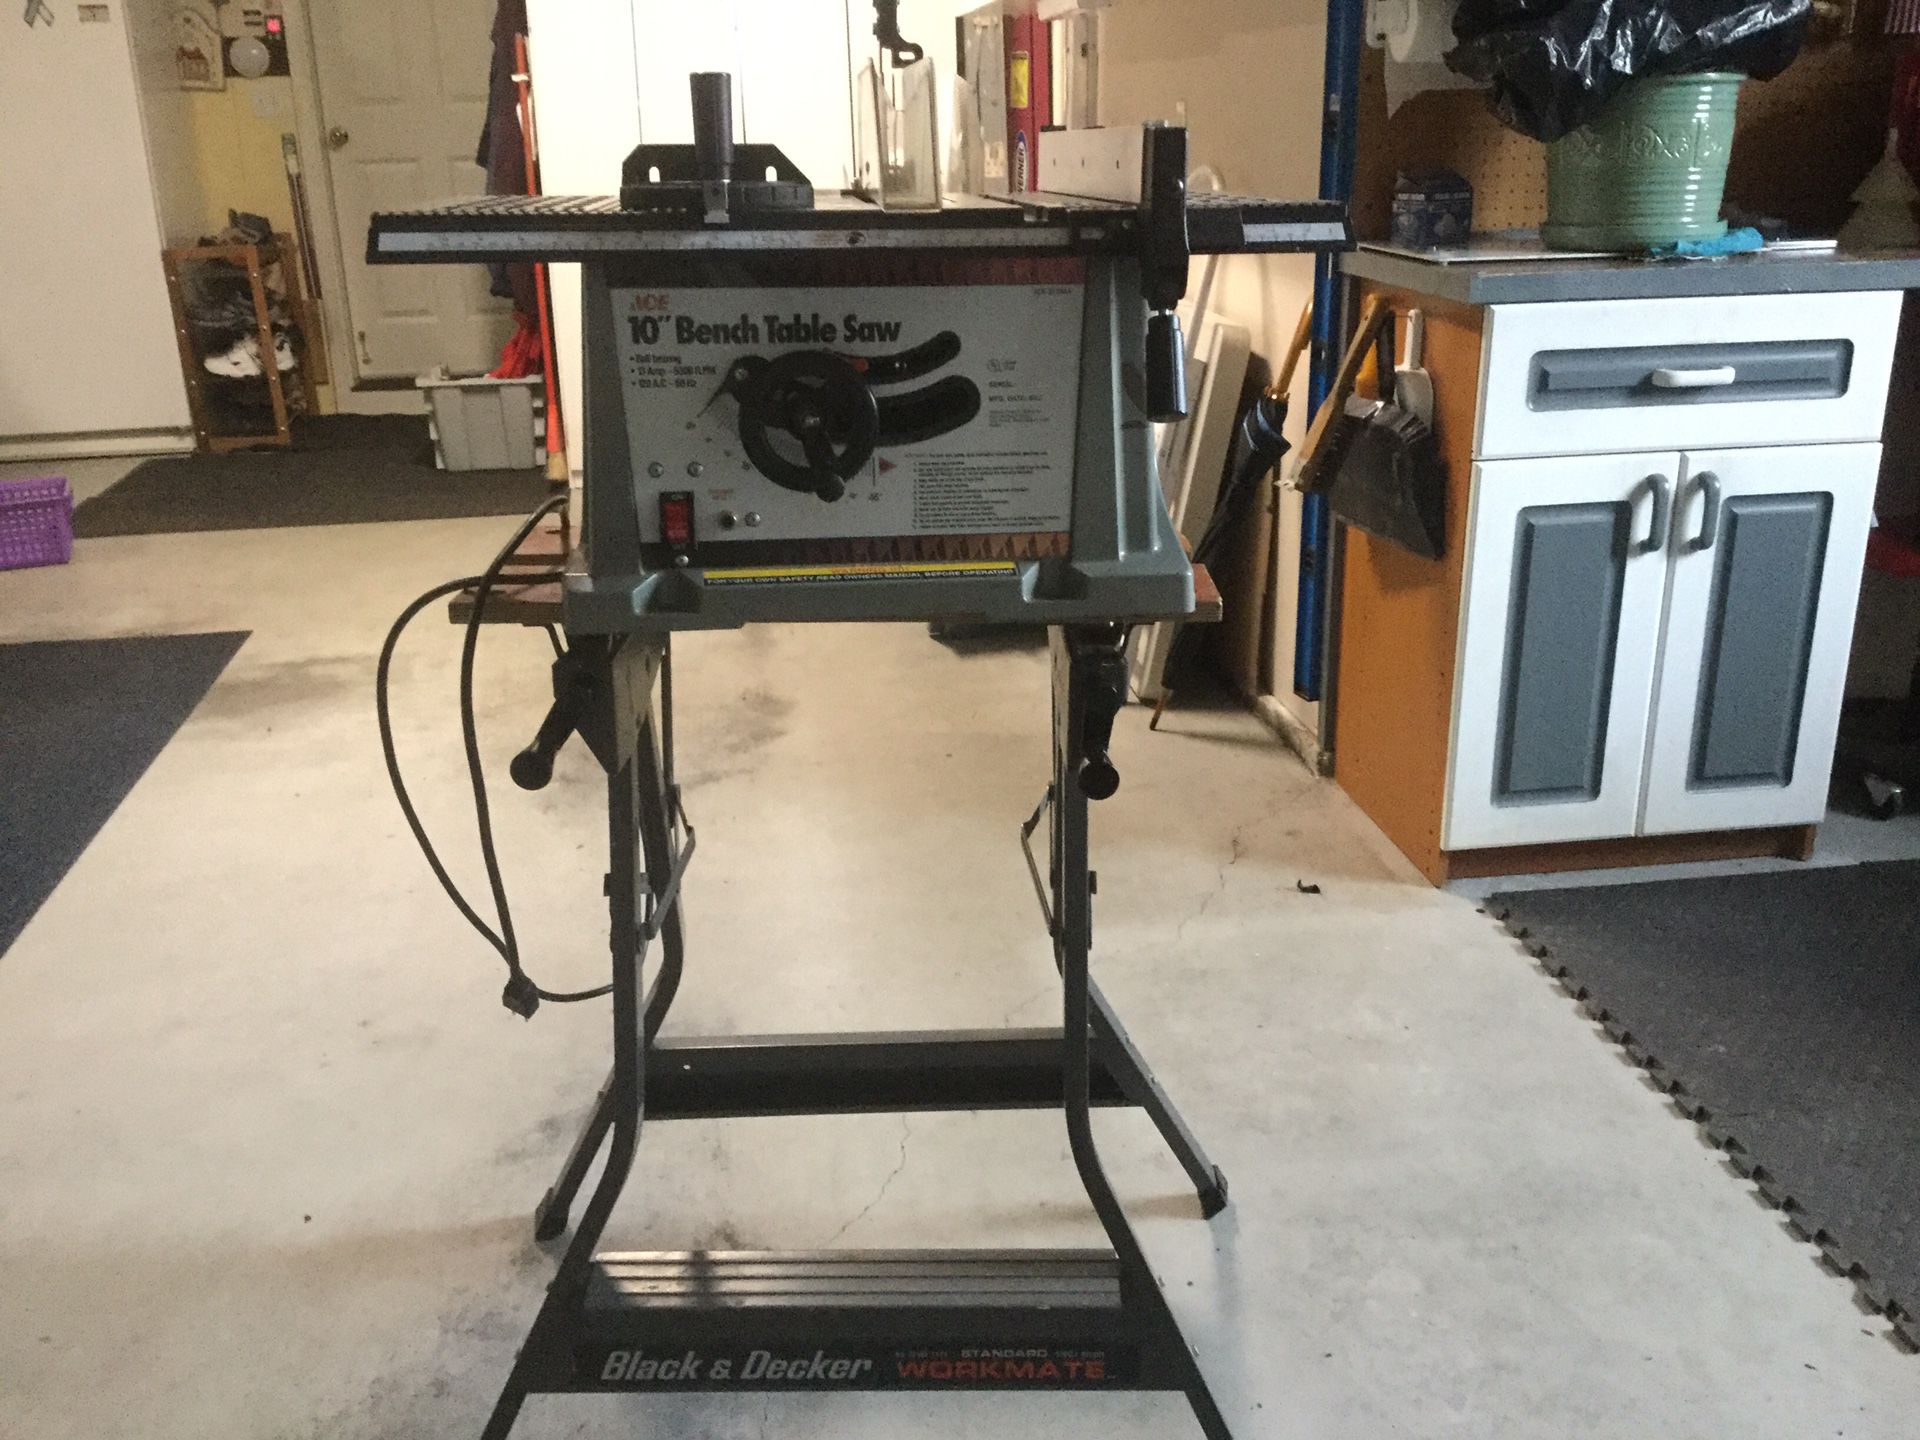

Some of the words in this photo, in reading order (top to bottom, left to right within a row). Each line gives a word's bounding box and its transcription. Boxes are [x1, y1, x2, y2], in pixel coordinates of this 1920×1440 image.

[676, 313, 759, 345] Bench
[763, 313, 837, 344] Table
[844, 314, 902, 343] Saw
[602, 1351, 701, 1380] Black
[709, 1358, 731, 1379] &
[740, 1351, 872, 1380] Decker
[896, 1360, 1105, 1379] WORKMATE
[961, 1349, 1049, 1358] STANDARD
